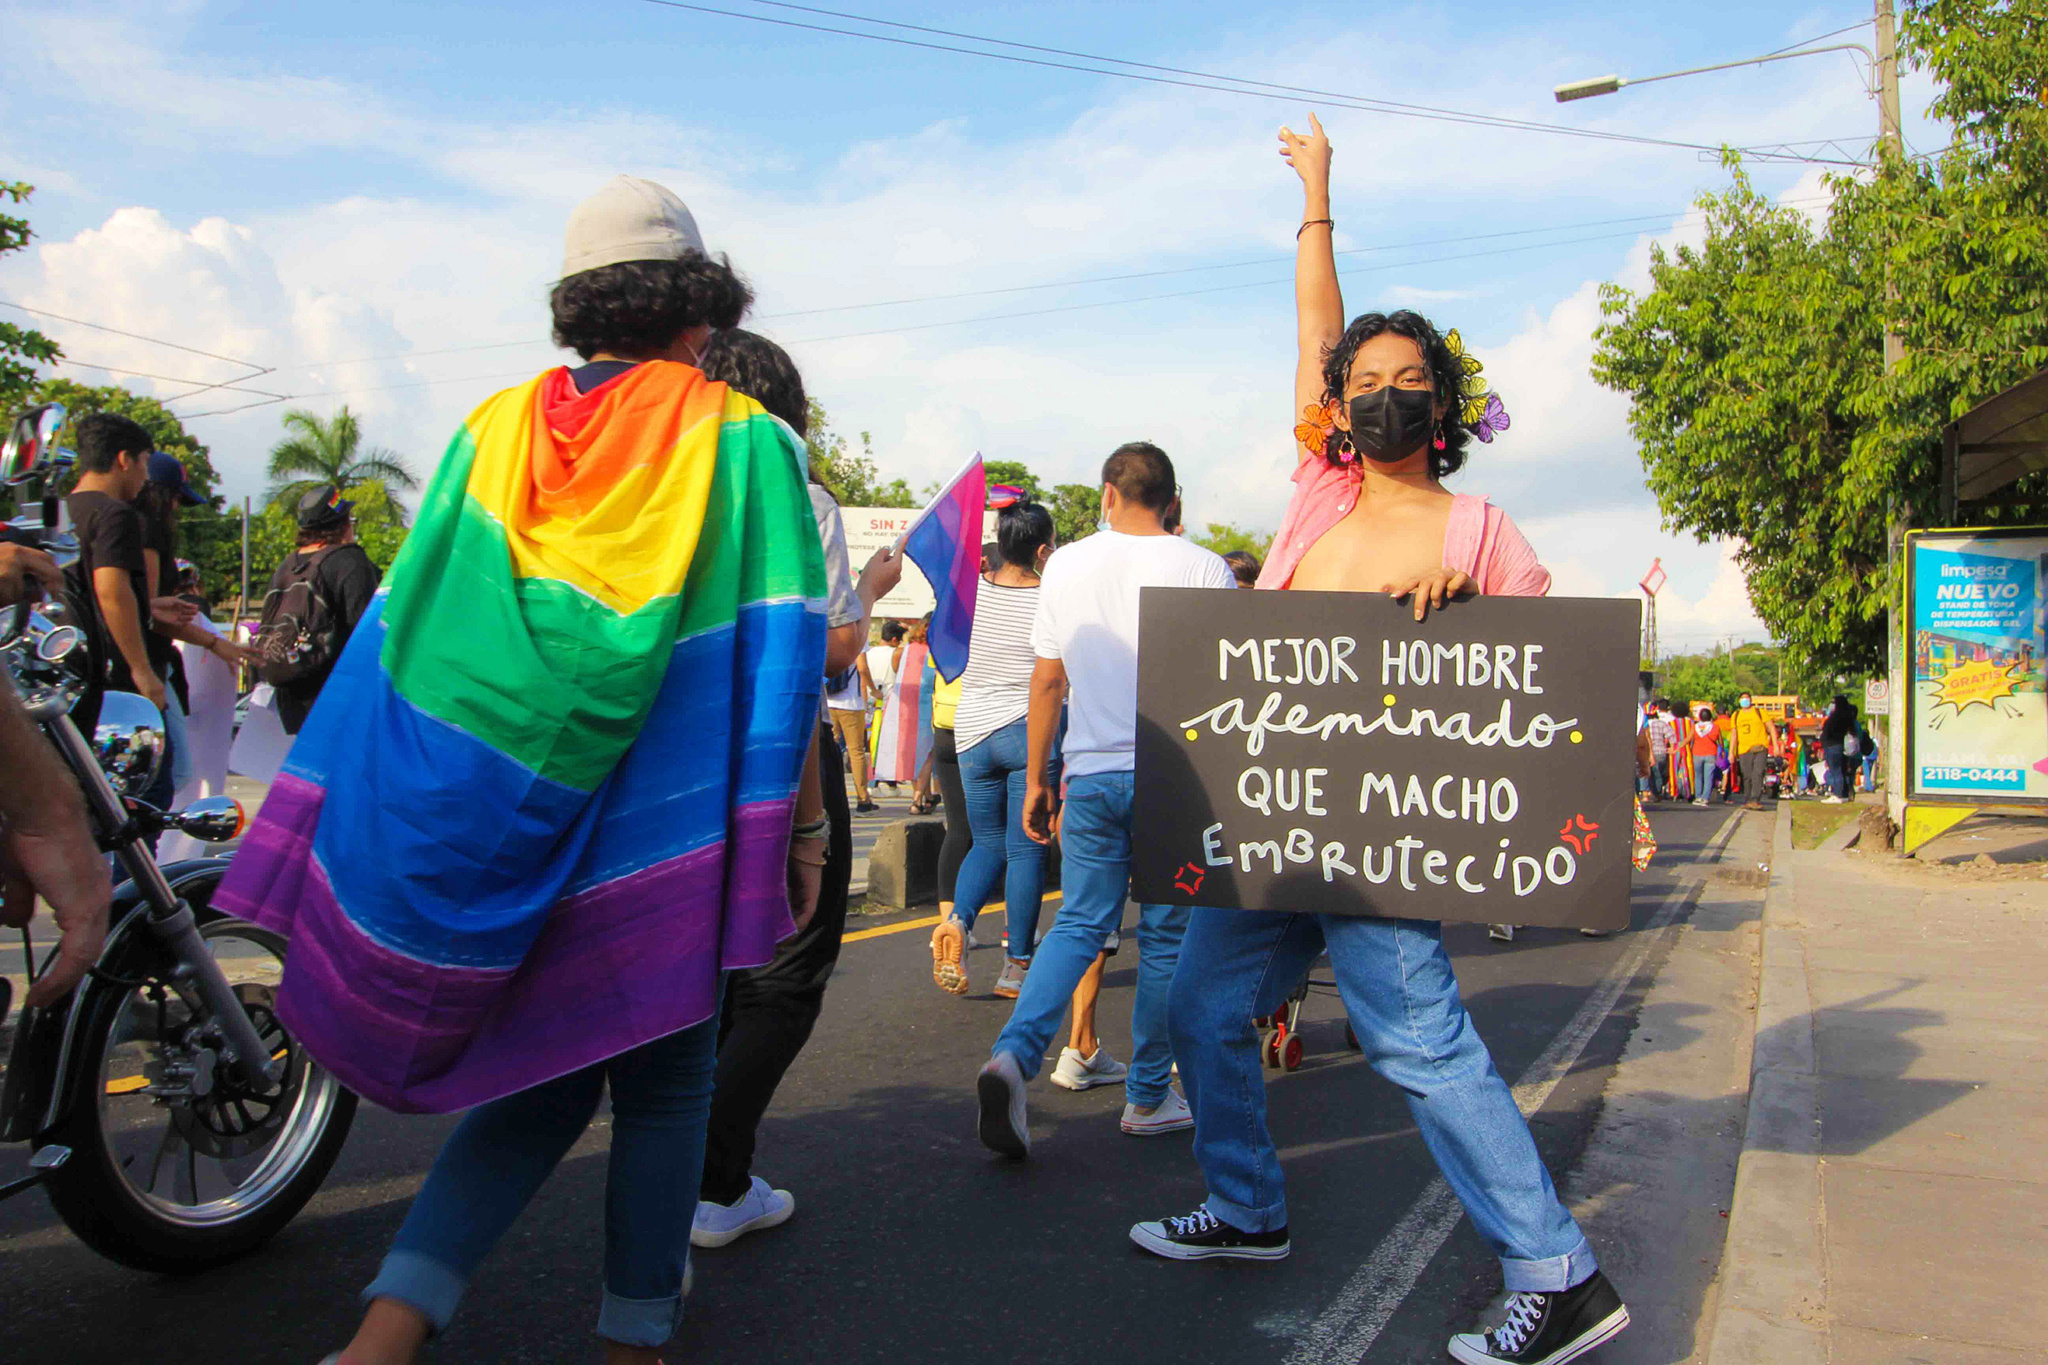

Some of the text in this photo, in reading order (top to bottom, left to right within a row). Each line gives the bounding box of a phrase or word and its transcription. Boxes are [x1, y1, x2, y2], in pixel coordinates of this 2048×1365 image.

[870, 519, 894, 531] SIN
[1940, 563, 2007, 578] limpesa
[1936, 583, 2020, 600] NUEVO
[1939, 601, 1971, 609] STAND
[1218, 636, 1544, 694] MEJOR HOMBRE
[1950, 669, 2002, 690] GRATIS
[1179, 692, 1578, 756] afeminado
[1925, 768, 2019, 783] 2118-0444
[1237, 765, 1520, 825] QUE MACHO
